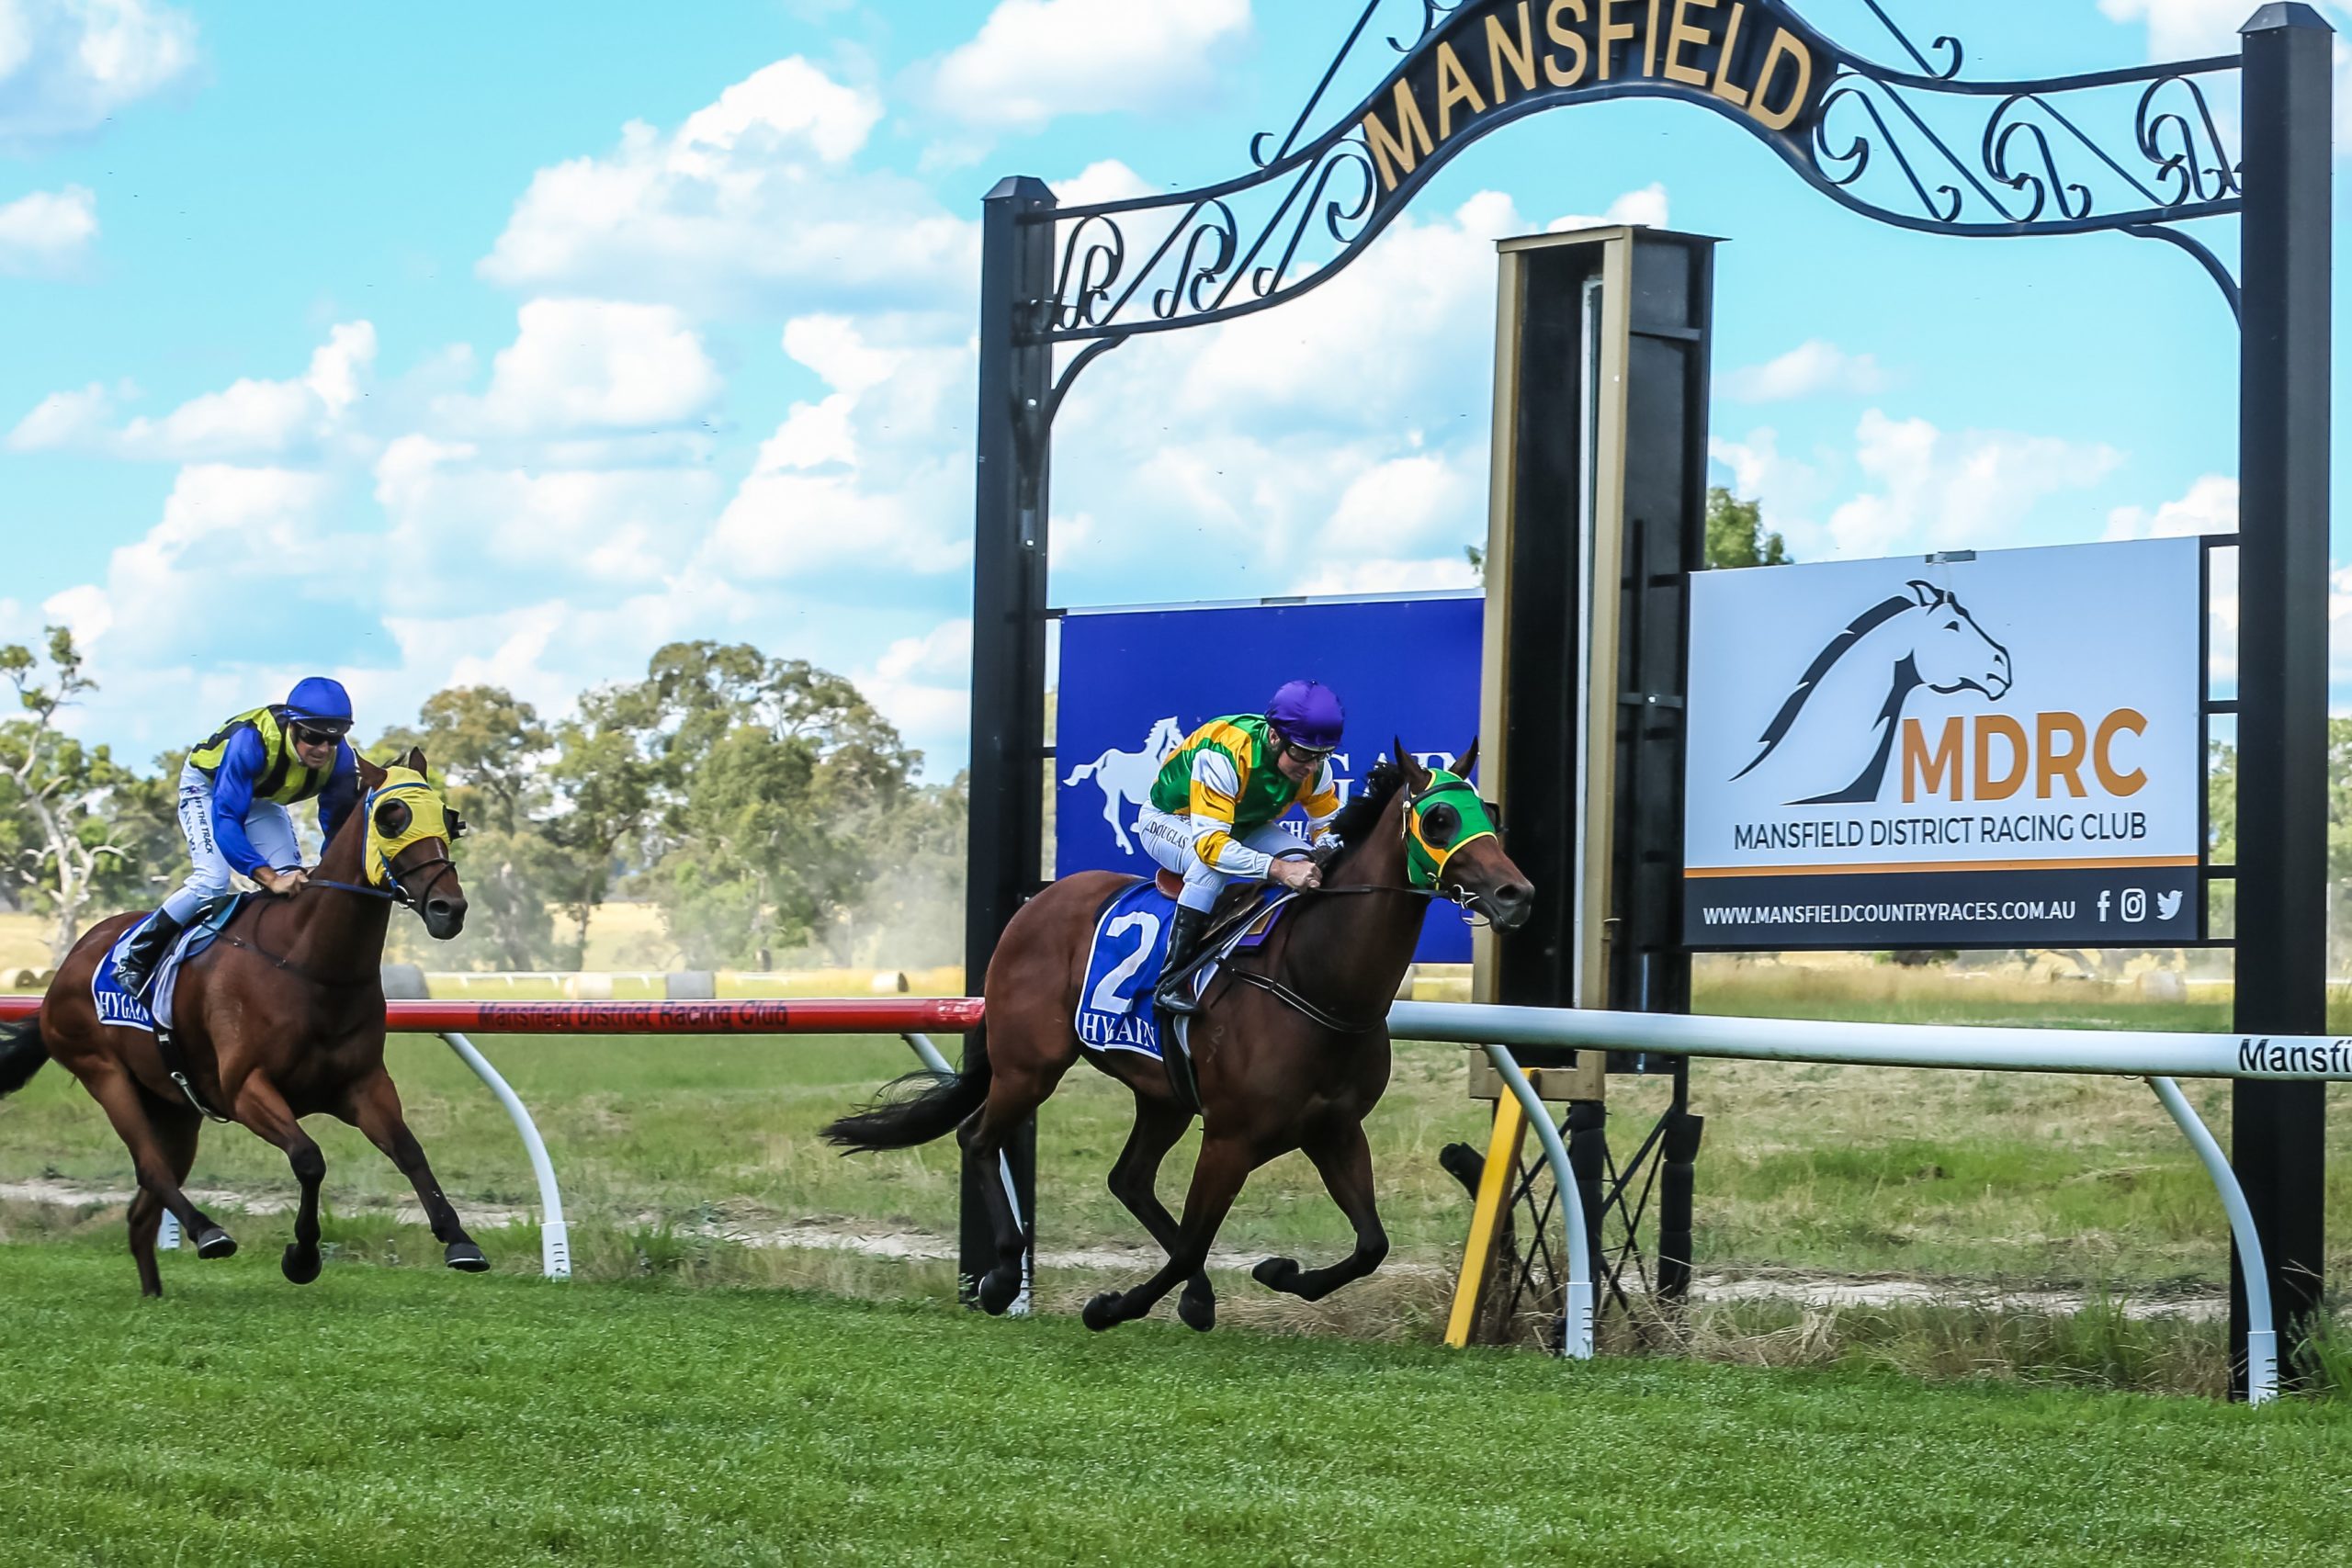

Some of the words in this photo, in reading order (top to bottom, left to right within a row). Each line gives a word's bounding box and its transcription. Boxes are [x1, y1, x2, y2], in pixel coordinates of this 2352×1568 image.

[1363, 0, 1812, 191] MANSFIELD
[1901, 707, 2148, 804] MDRC
[1734, 820, 1864, 850] MANSFIELD
[1871, 817, 1974, 846] DISTRICT
[1981, 814, 2074, 843] RACING
[2081, 812, 2146, 840] CLUB
[1702, 900, 2076, 925] WWW.MANSFIELDCOUNTRYRACES.COM.AU
[1091, 911, 1160, 1015] 2
[479, 1001, 572, 1028] Mansfield
[578, 1001, 651, 1027] District
[738, 999, 788, 1026] Club
